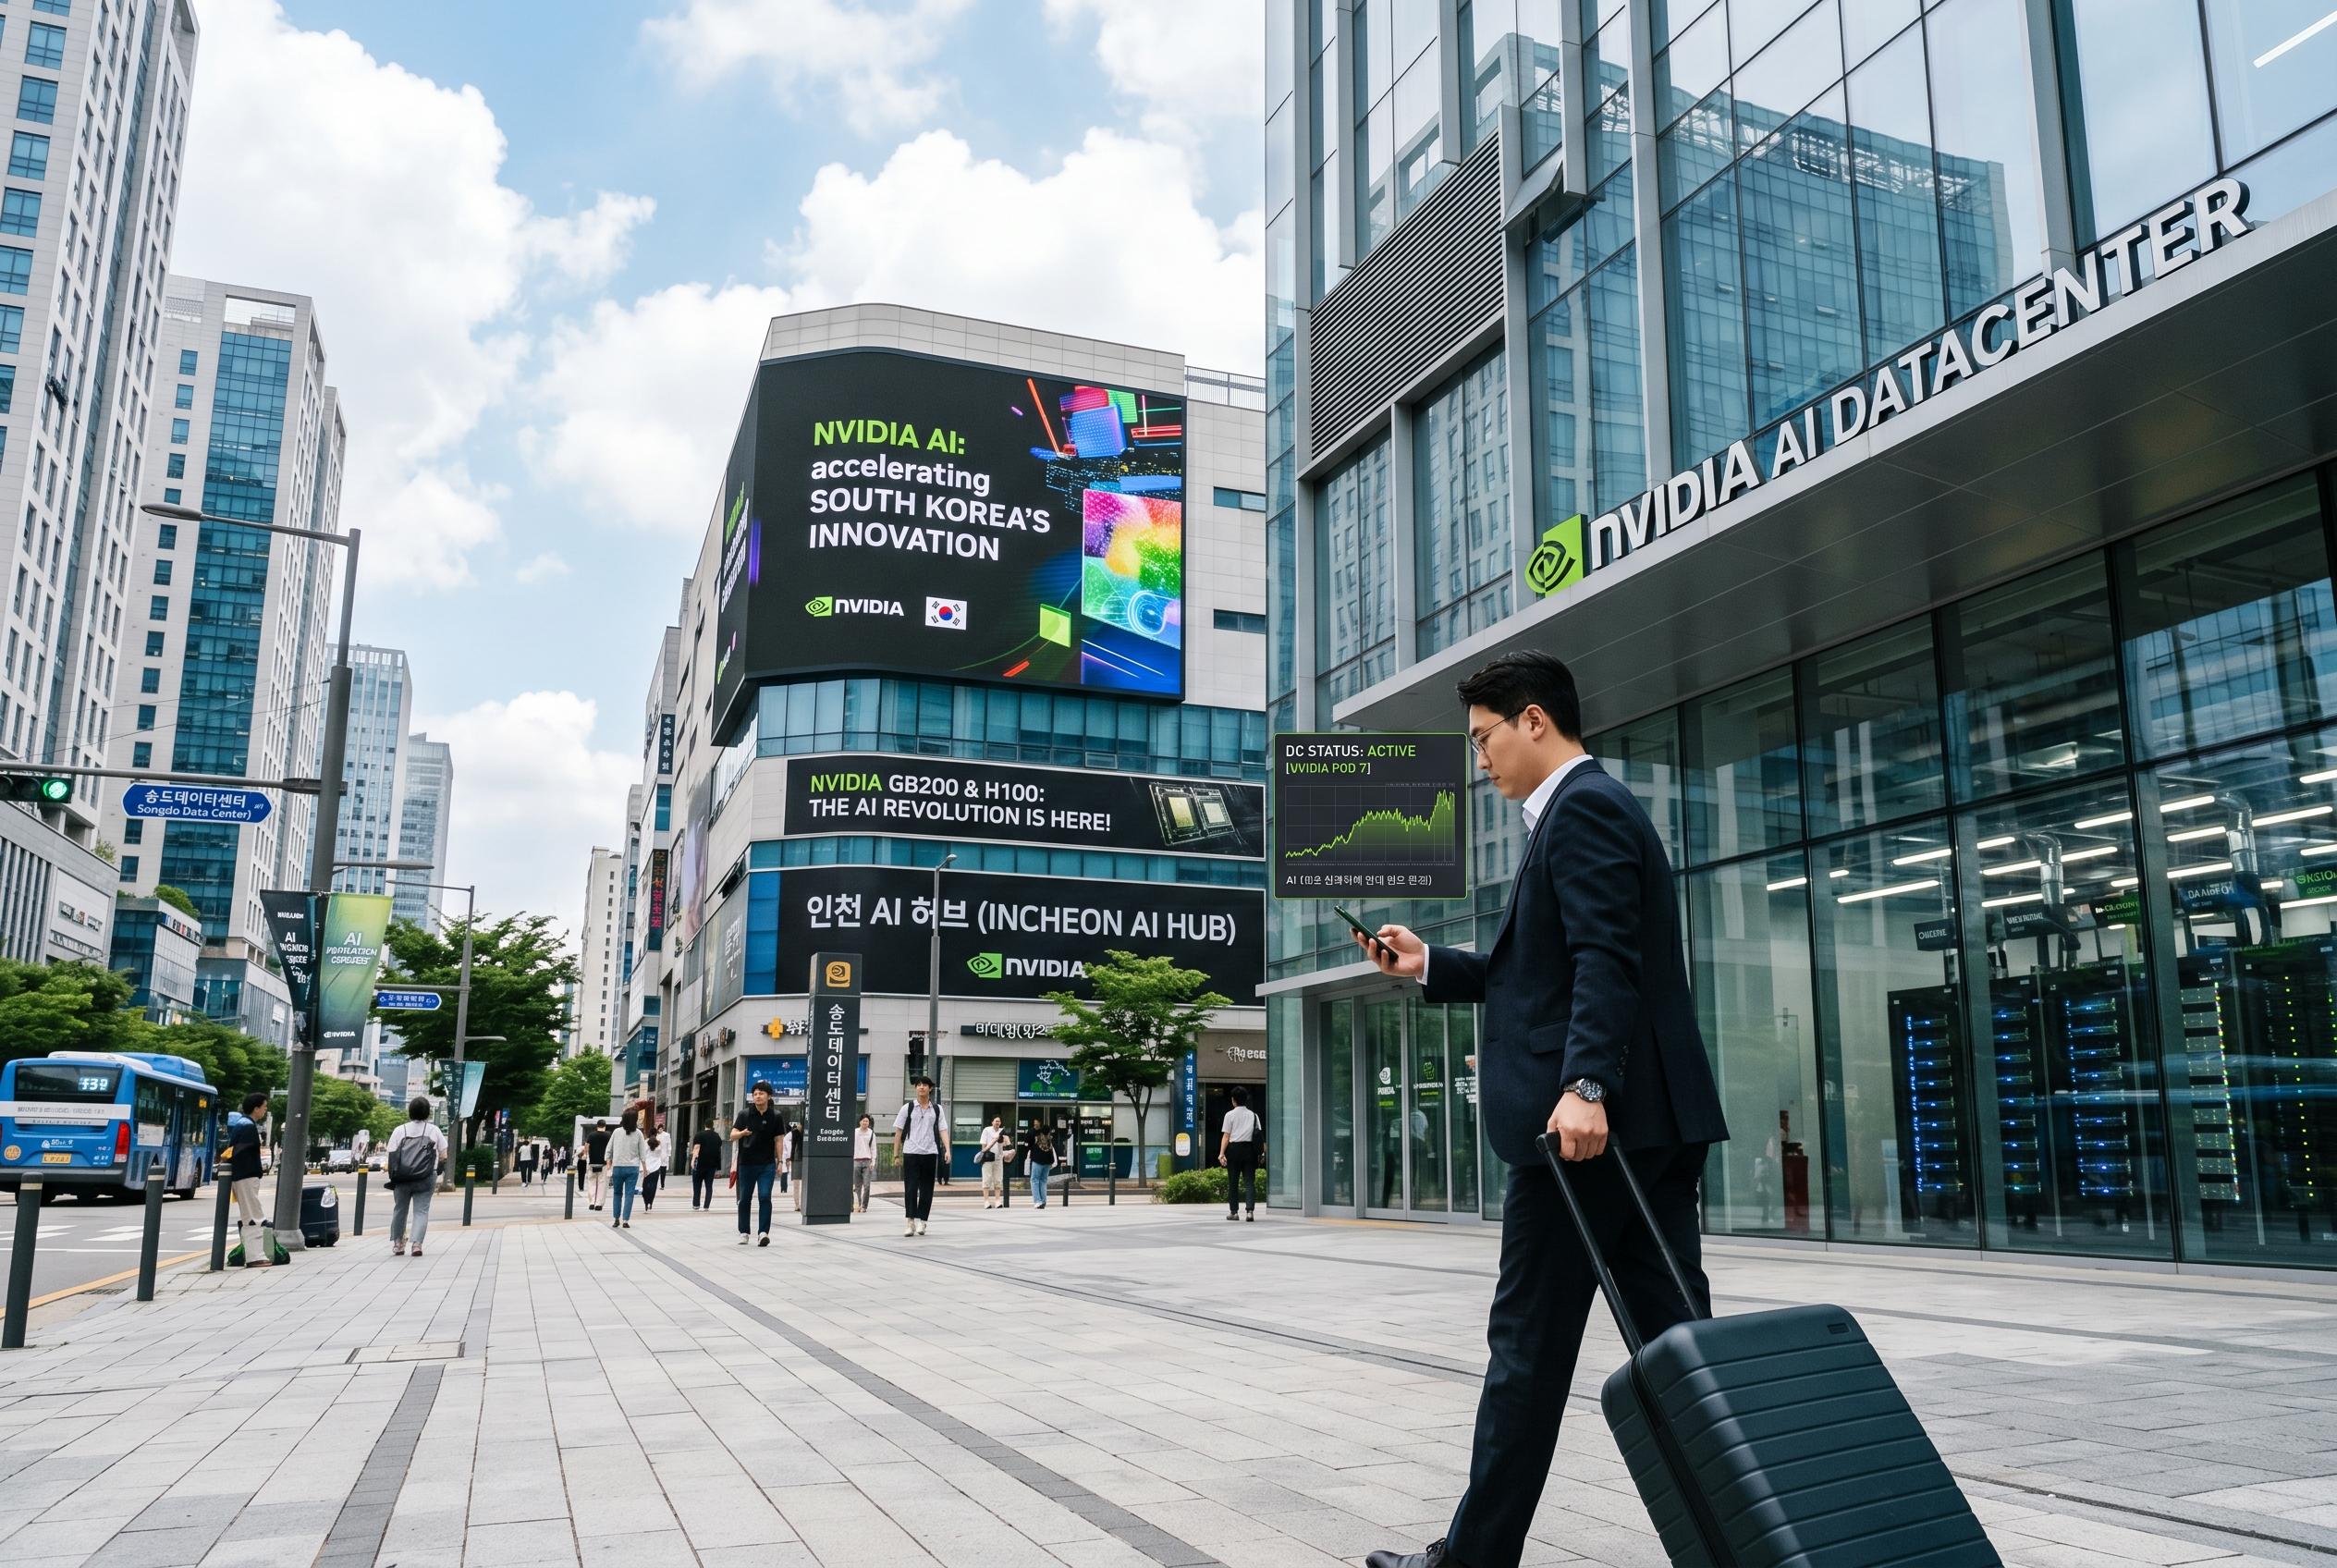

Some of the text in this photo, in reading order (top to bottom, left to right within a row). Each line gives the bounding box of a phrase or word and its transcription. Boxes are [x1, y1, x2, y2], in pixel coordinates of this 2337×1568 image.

[1771, 406, 1824, 480] AI
[1831, 177, 2253, 447] DATACENTER
[814, 420, 965, 455] NVIDIA AI:
[811, 454, 990, 497] accelerating
[810, 487, 1051, 533] SOUTH KOREA’S
[809, 521, 999, 561] INNOVATION
[1286, 745, 1416, 757] DC STATUS: ACTIVE
[1332, 763, 1356, 774] POD
[1359, 763, 1371, 775] 7]
[810, 773, 1045, 802] NVIDIA GB200 & H100:
[137, 804, 251, 821] Songdo Data Center)
[809, 798, 1111, 832] THE AI REVOLUTION IS HERE!
[1286, 876, 1296, 885] AI
[806, 893, 1236, 946] 인천 AI 허브 (INCHEON AI HUB)
[285, 932, 296, 943] AI
[343, 931, 363, 947] AI
[825, 1003, 846, 1122] 송도데이터센터
